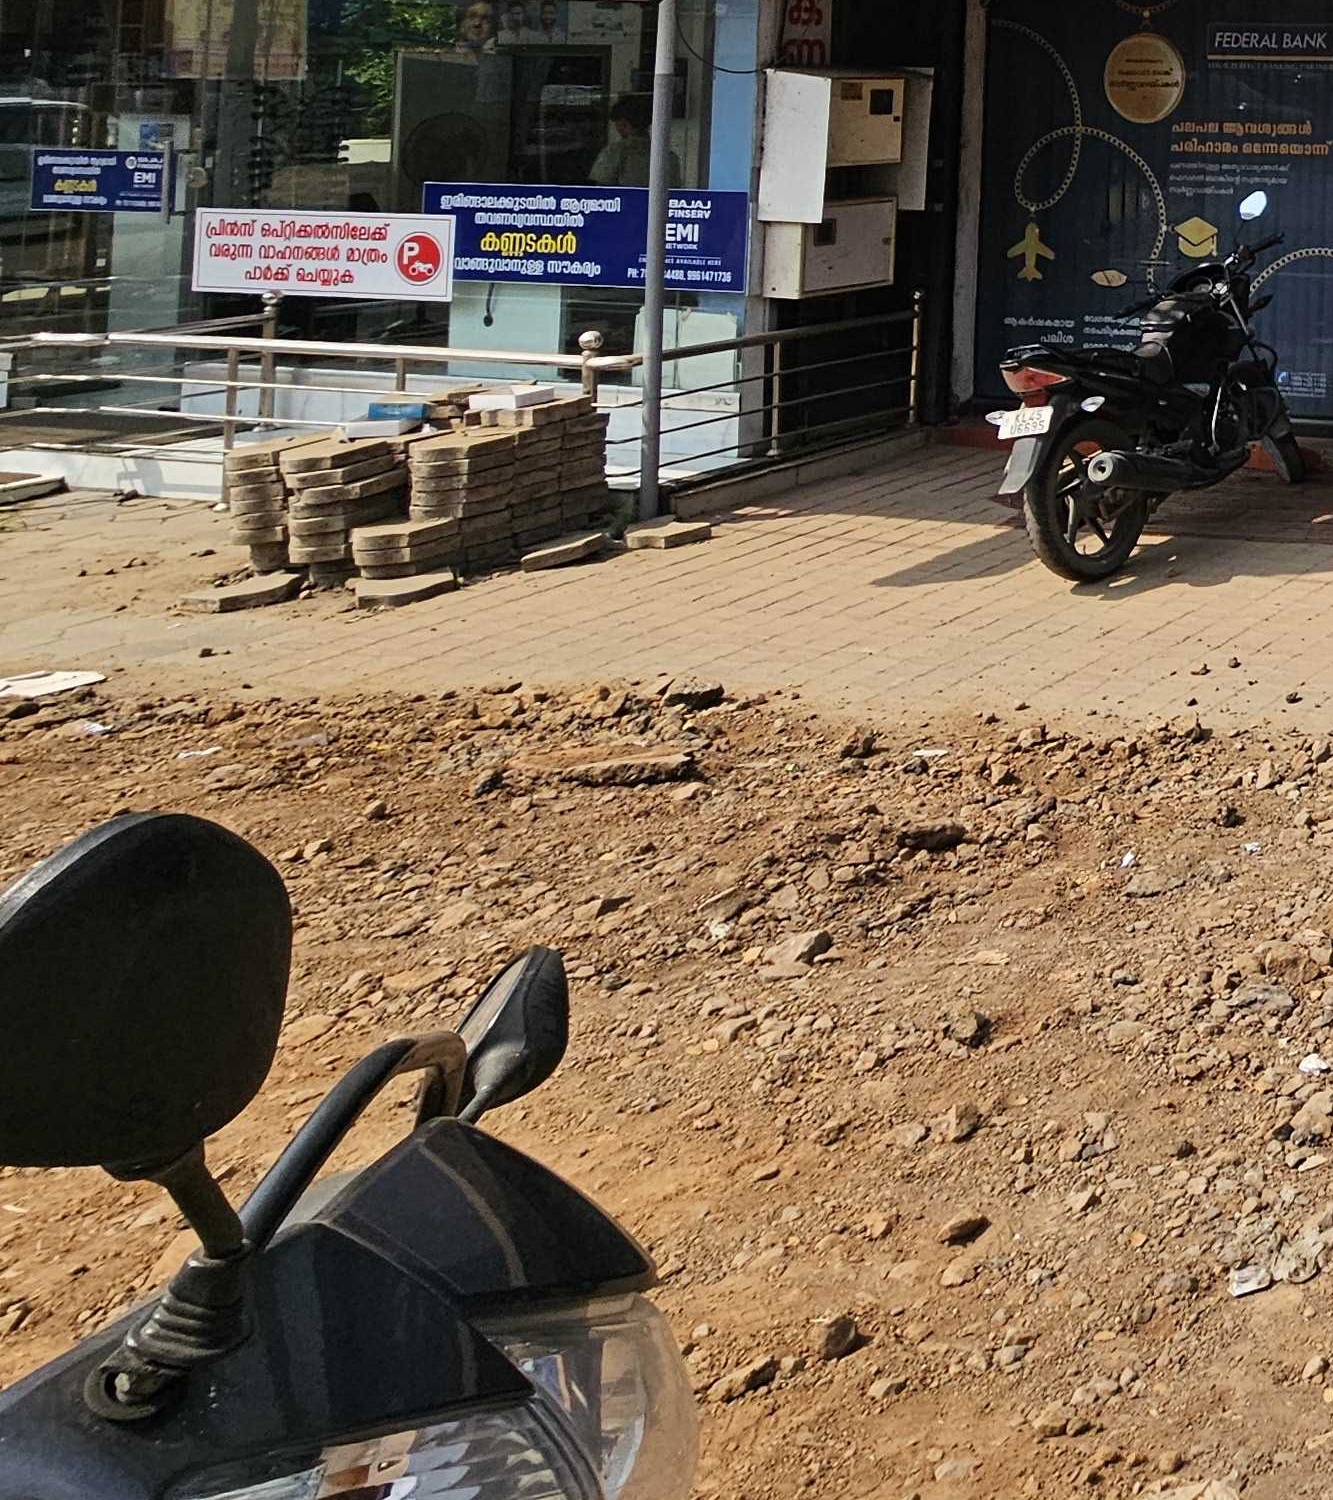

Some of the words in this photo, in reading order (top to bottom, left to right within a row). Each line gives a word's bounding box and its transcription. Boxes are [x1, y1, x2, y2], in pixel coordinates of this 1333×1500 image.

[1213, 31, 1278, 49] FEDERAL
[1282, 32, 1328, 50] BANK
[668, 199, 712, 209] BAJAJ
[668, 209, 712, 220] FINSERV
[205, 218, 255, 239] പ്രിൻസ്
[665, 223, 699, 243] EMI
[209, 243, 253, 260] വരുന്ന
[259, 244, 340, 262] വാഹനങ്ങൾ
[346, 246, 388, 265] മാത്രം
[480, 231, 577, 257] കണ്ണടകൾ
[245, 263, 293, 282] പാർക്ക്
[296, 266, 354, 286] ചെയ്യുക
